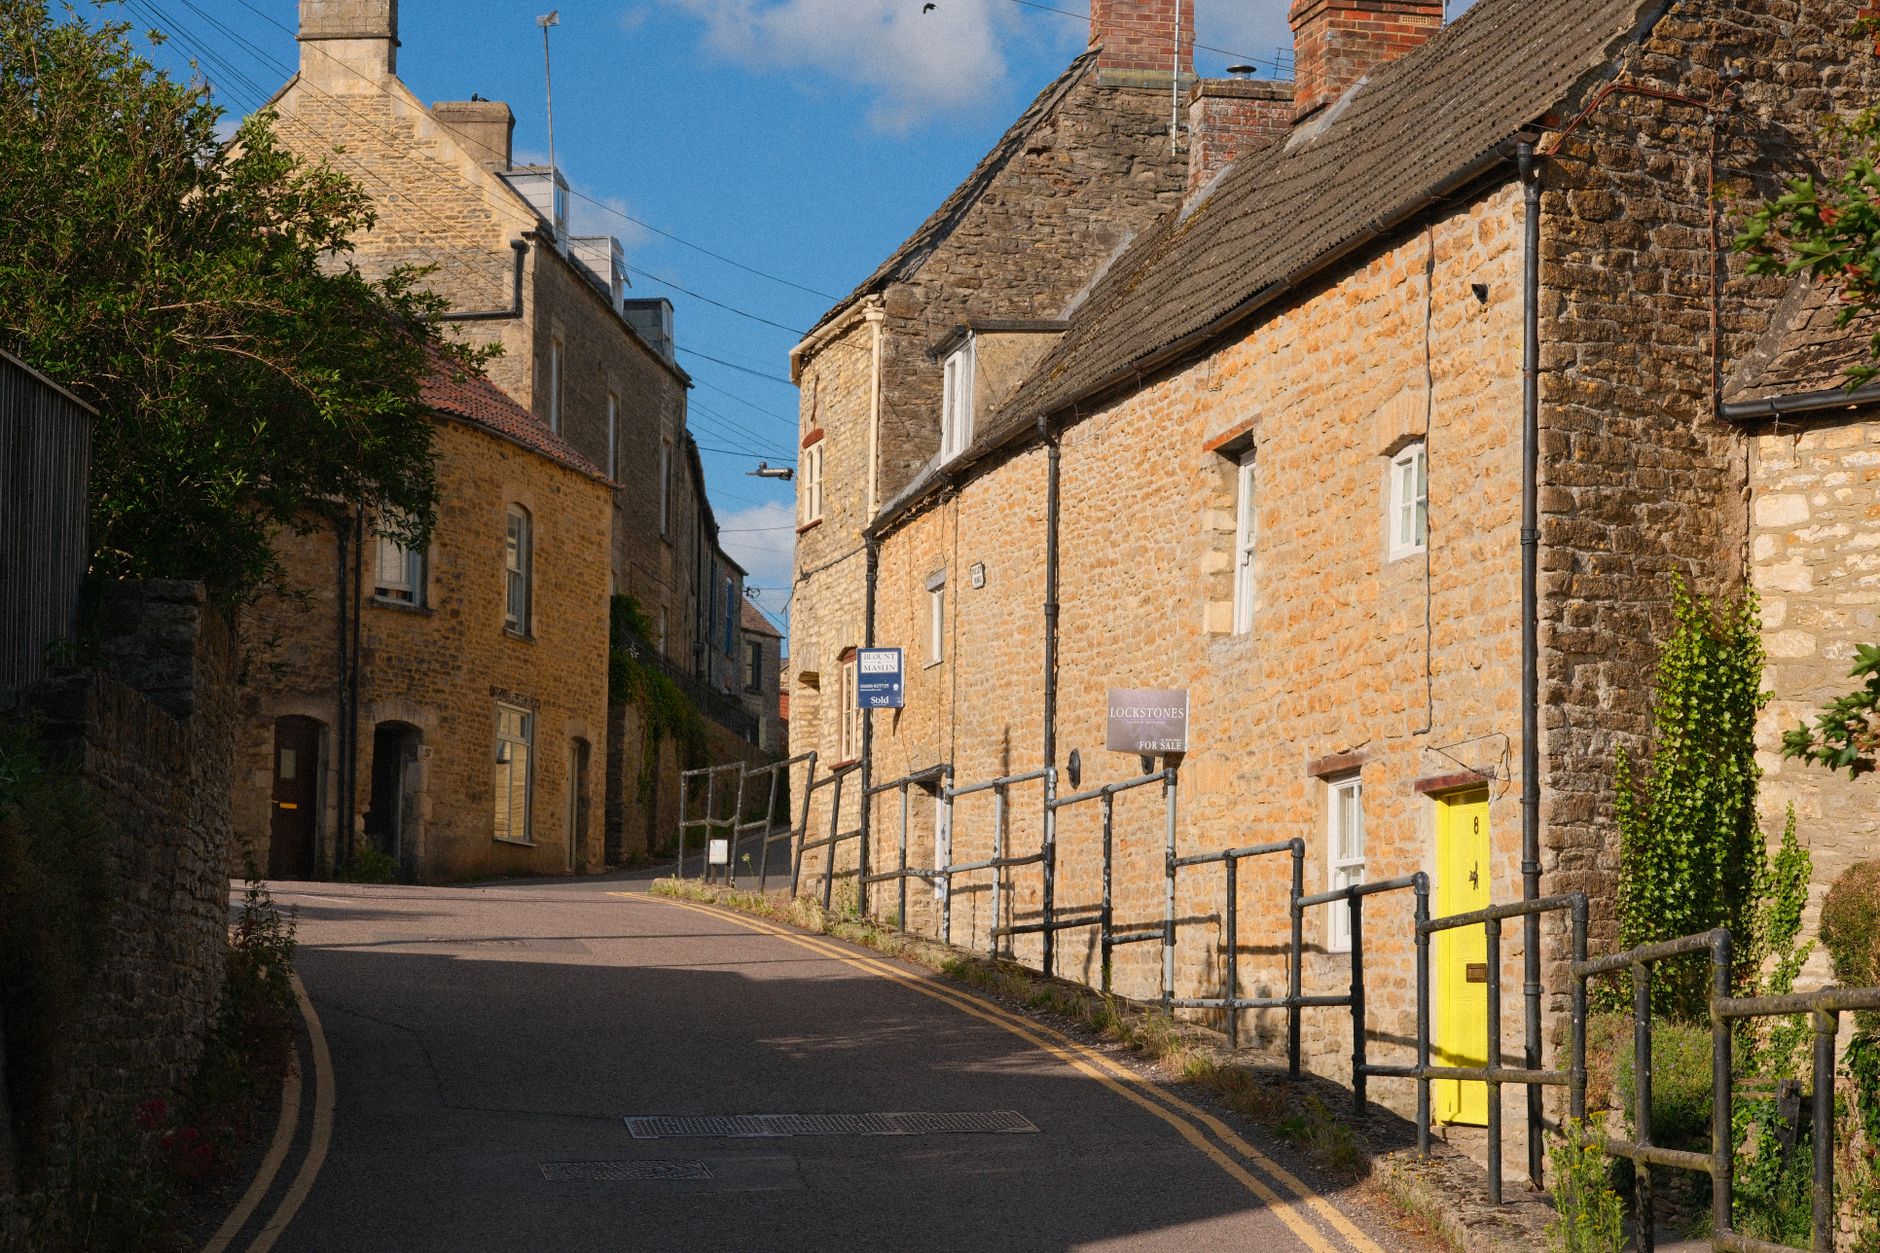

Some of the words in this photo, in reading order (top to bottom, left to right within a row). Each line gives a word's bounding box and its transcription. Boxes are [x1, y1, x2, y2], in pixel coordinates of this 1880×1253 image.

[870, 696, 889, 704] Sold
[1110, 707, 1184, 718] LOCKSTONES
[1140, 740, 1158, 750] FOR
[1160, 741, 1182, 750] SALE
[1474, 816, 1479, 834] 8
